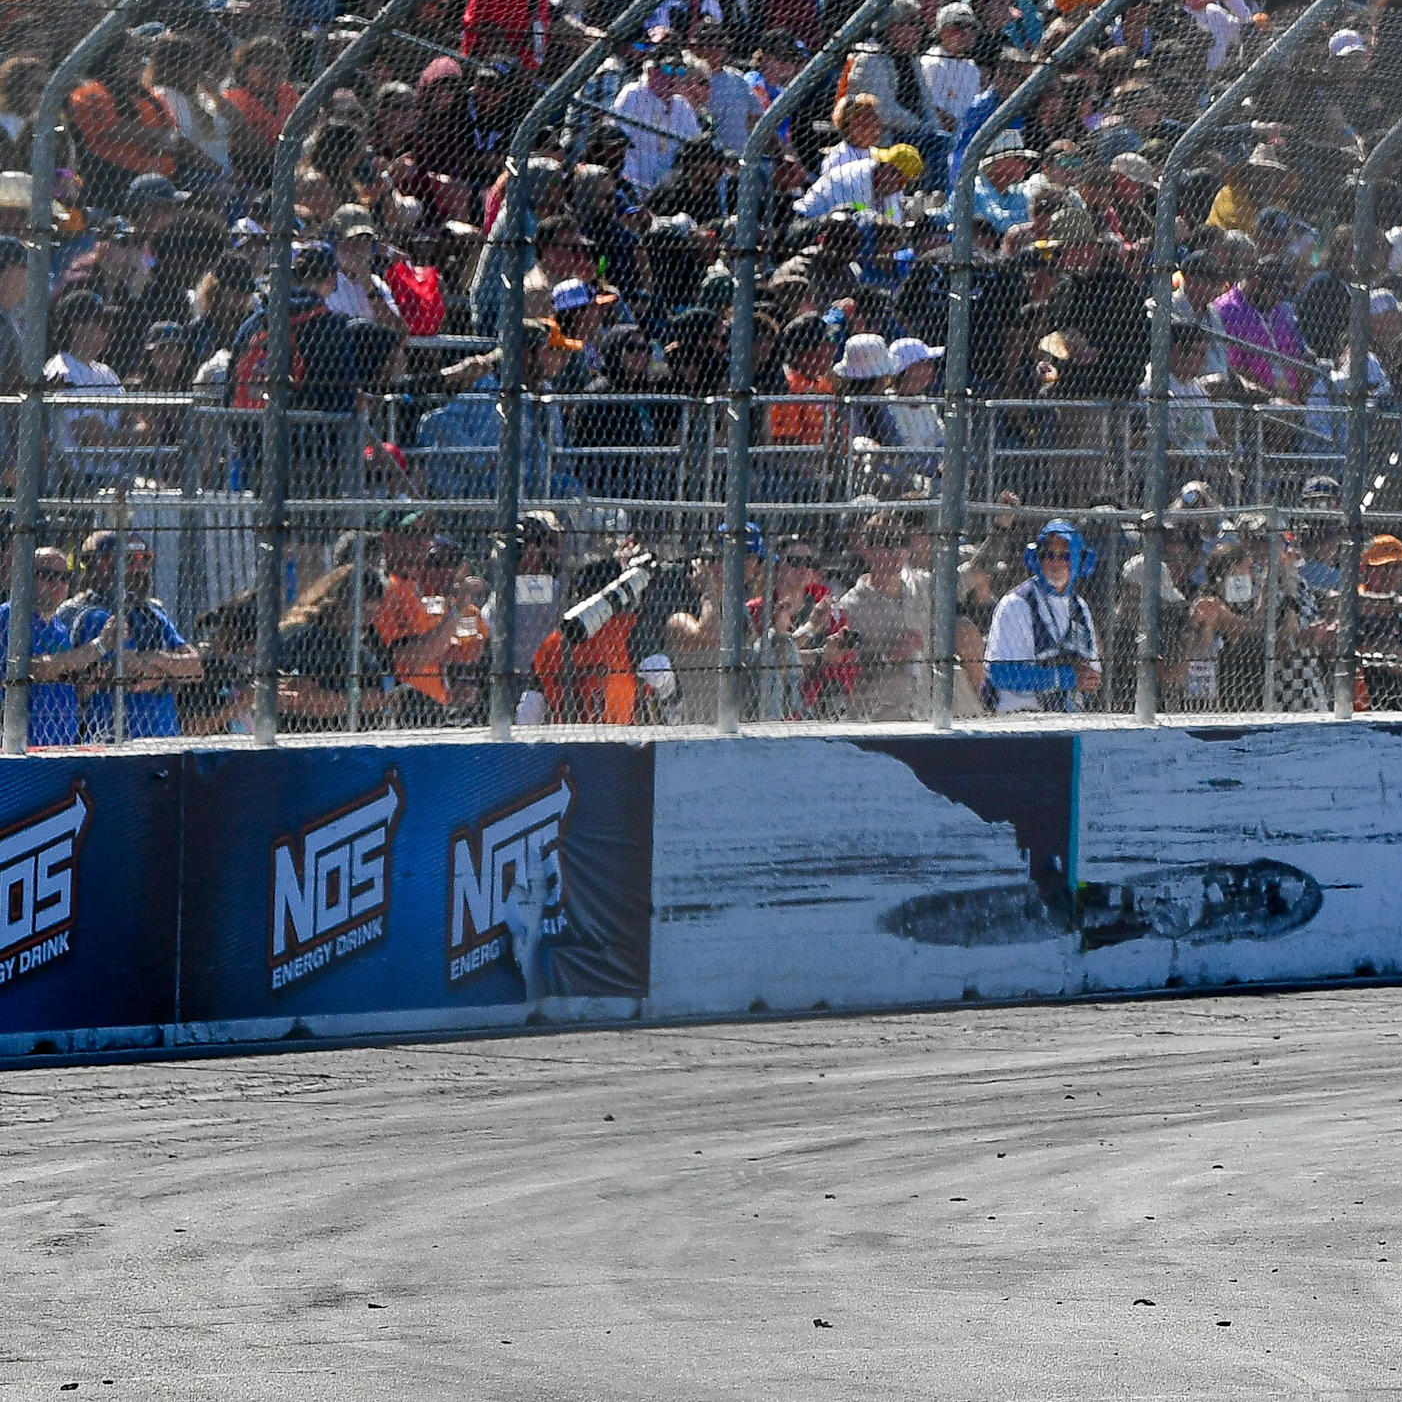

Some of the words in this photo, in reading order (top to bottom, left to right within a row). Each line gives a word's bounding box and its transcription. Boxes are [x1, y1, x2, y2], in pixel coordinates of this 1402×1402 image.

[0, 793, 88, 951] OS
[273, 784, 398, 956] NOS
[19, 931, 70, 974] DRINK
[272, 942, 334, 990] ENERGY
[334, 916, 383, 960] DRINK
[450, 939, 500, 981] ENERG
